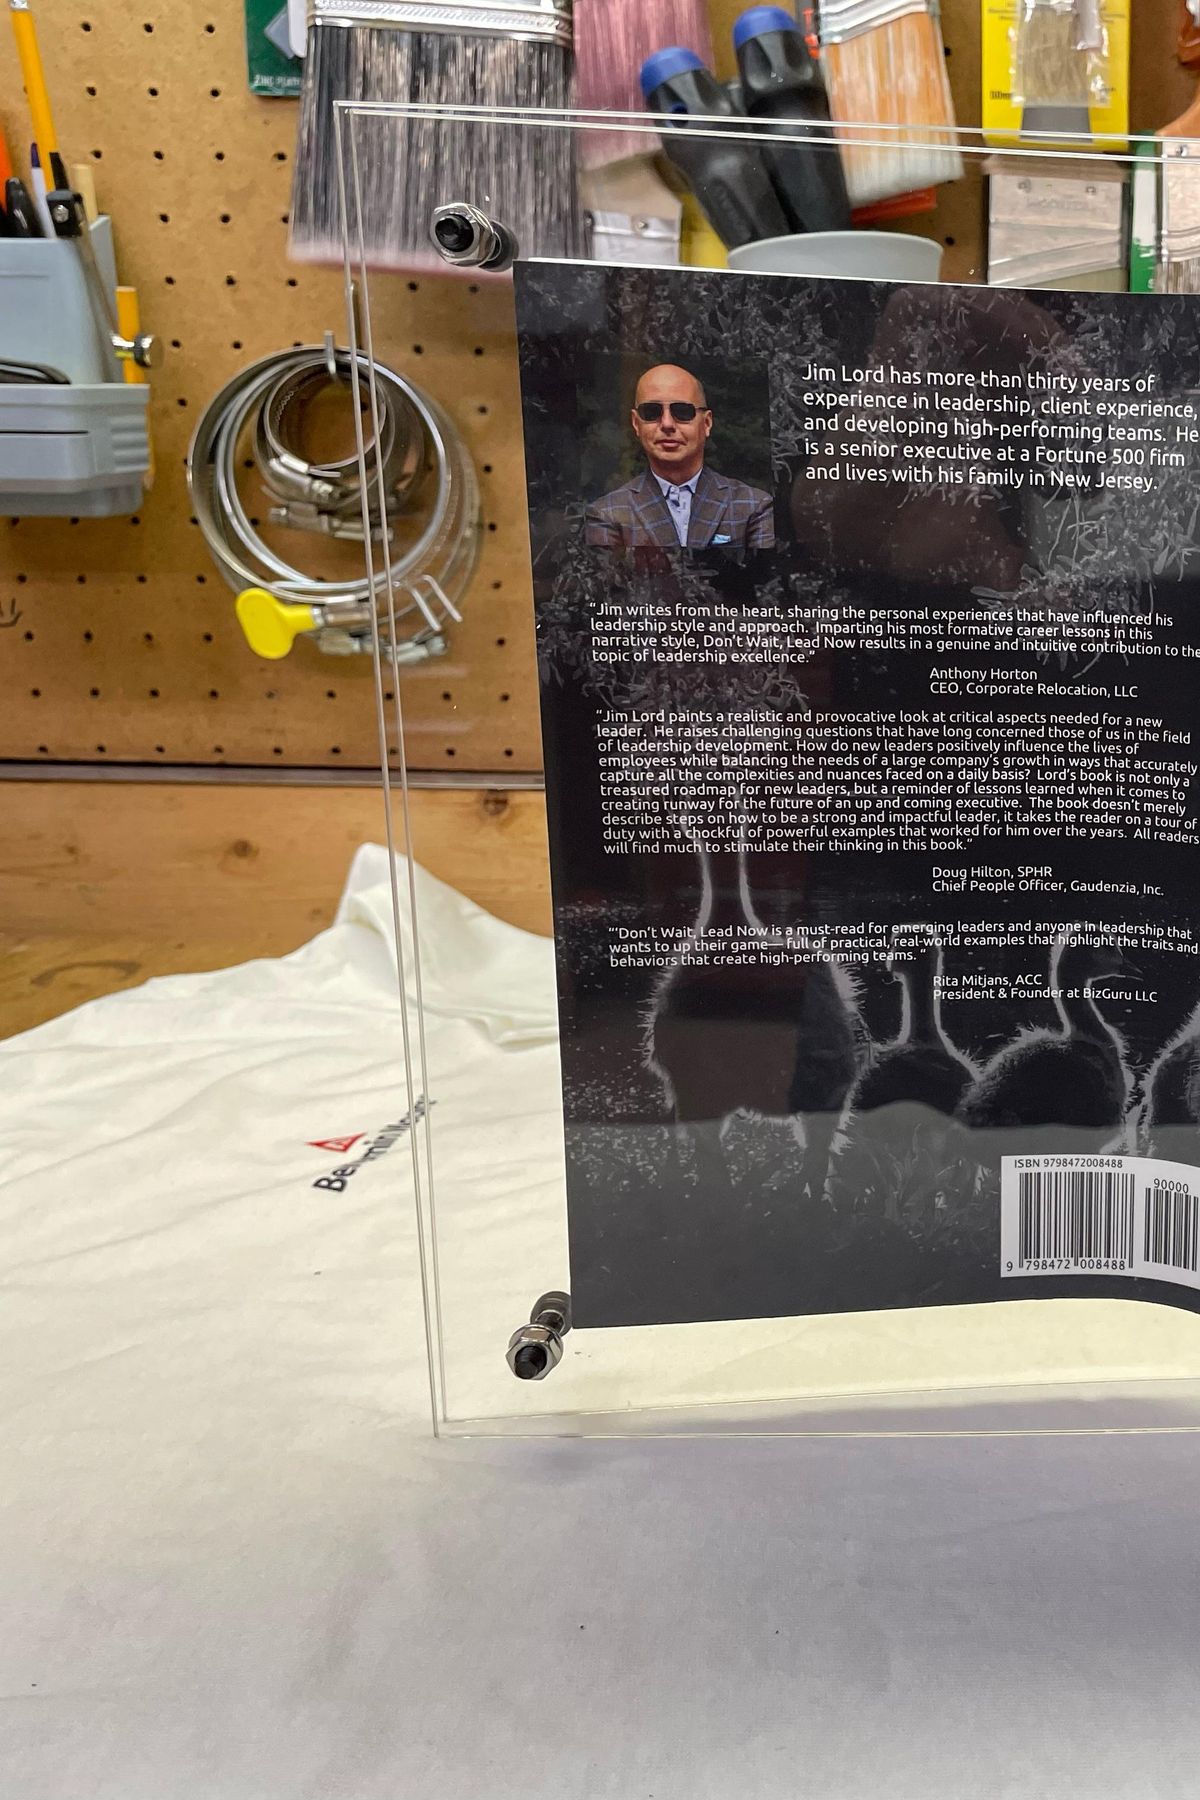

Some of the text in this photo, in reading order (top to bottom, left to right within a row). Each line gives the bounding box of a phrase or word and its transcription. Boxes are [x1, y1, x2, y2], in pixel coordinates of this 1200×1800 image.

[802, 363, 1156, 395] Jim Lord has more than thirty years of
[803, 389, 1198, 421] experience in leadership, client experience,
[804, 413, 1199, 443] and developing high-performing teams. He
[805, 438, 1185, 467] is a senior executive at a Fortune 500 firm
[805, 462, 1158, 493] and lives with his family in New Jersey.
[625, 603, 672, 616] writes
[675, 604, 711, 617] from
[714, 604, 738, 618] the
[742, 605, 784, 620] heart,
[787, 606, 839, 622] sharing
[842, 606, 866, 620] the
[869, 607, 929, 624] personal
[932, 608, 1014, 625] experiences
[1016, 610, 1045, 623] that
[1047, 611, 1080, 624] have
[1082, 611, 1152, 626] influenced
[1155, 613, 1173, 626] his
[592, 650, 630, 666] topic
[633, 650, 649, 663] of
[652, 650, 728, 666] leadership
[929, 667, 1037, 683] Anthony Horton
[930, 682, 1138, 699] CEO, Corporate Relocation, LLC
[632, 710, 665, 722] Lord
[668, 710, 713, 725] paints
[715, 713, 724, 722] a
[727, 710, 783, 722] realistic
[786, 710, 812, 722] and
[815, 710, 896, 725] provocative
[899, 710, 929, 723] look
[932, 711, 946, 723] at
[949, 711, 994, 724] critical
[996, 711, 1047, 727] aspects
[1050, 712, 1099, 726] needed
[1102, 714, 1122, 726] for
[1124, 717, 1132, 727] a
[1135, 717, 1163, 727] new
[597, 739, 1139, 755] of leadership development. How do new leaders positively influence the lives of
[603, 841, 629, 853] will
[632, 841, 660, 853] find
[663, 840, 703, 853] much
[705, 840, 721, 852] to
[723, 840, 789, 852] stimulate
[792, 839, 825, 852] their
[828, 839, 884, 854] thinking
[886, 839, 899, 851] in
[902, 839, 927, 851] this
[932, 865, 1052, 881] Doug Hilton, SPHR
[932, 880, 1165, 896] Chief People Officer, Gaudenzia, Inc.
[609, 940, 651, 953] wants
[654, 940, 670, 952] to
[673, 942, 691, 955] up
[694, 939, 728, 952] their
[786, 938, 809, 950] full
[812, 937, 827, 950] of
[830, 937, 890, 952] practical,
[894, 935, 960, 949] real-world
[963, 934, 1025, 950] examples
[1027, 934, 1054, 946] that
[1057, 934, 1115, 948] highlight
[1117, 937, 1139, 951] the
[1141, 939, 1174, 953] traits
[1176, 941, 1198, 954] and
[933, 973, 1042, 989] Rita Mitjans, ACC
[933, 987, 1157, 1002] President & Founder at BizGuru LLC
[1014, 1158, 1123, 1168] ISBN 9798472008488
[1153, 1178, 1189, 1194] 90000
[1006, 1258, 1126, 1272] 9 798472 008488
